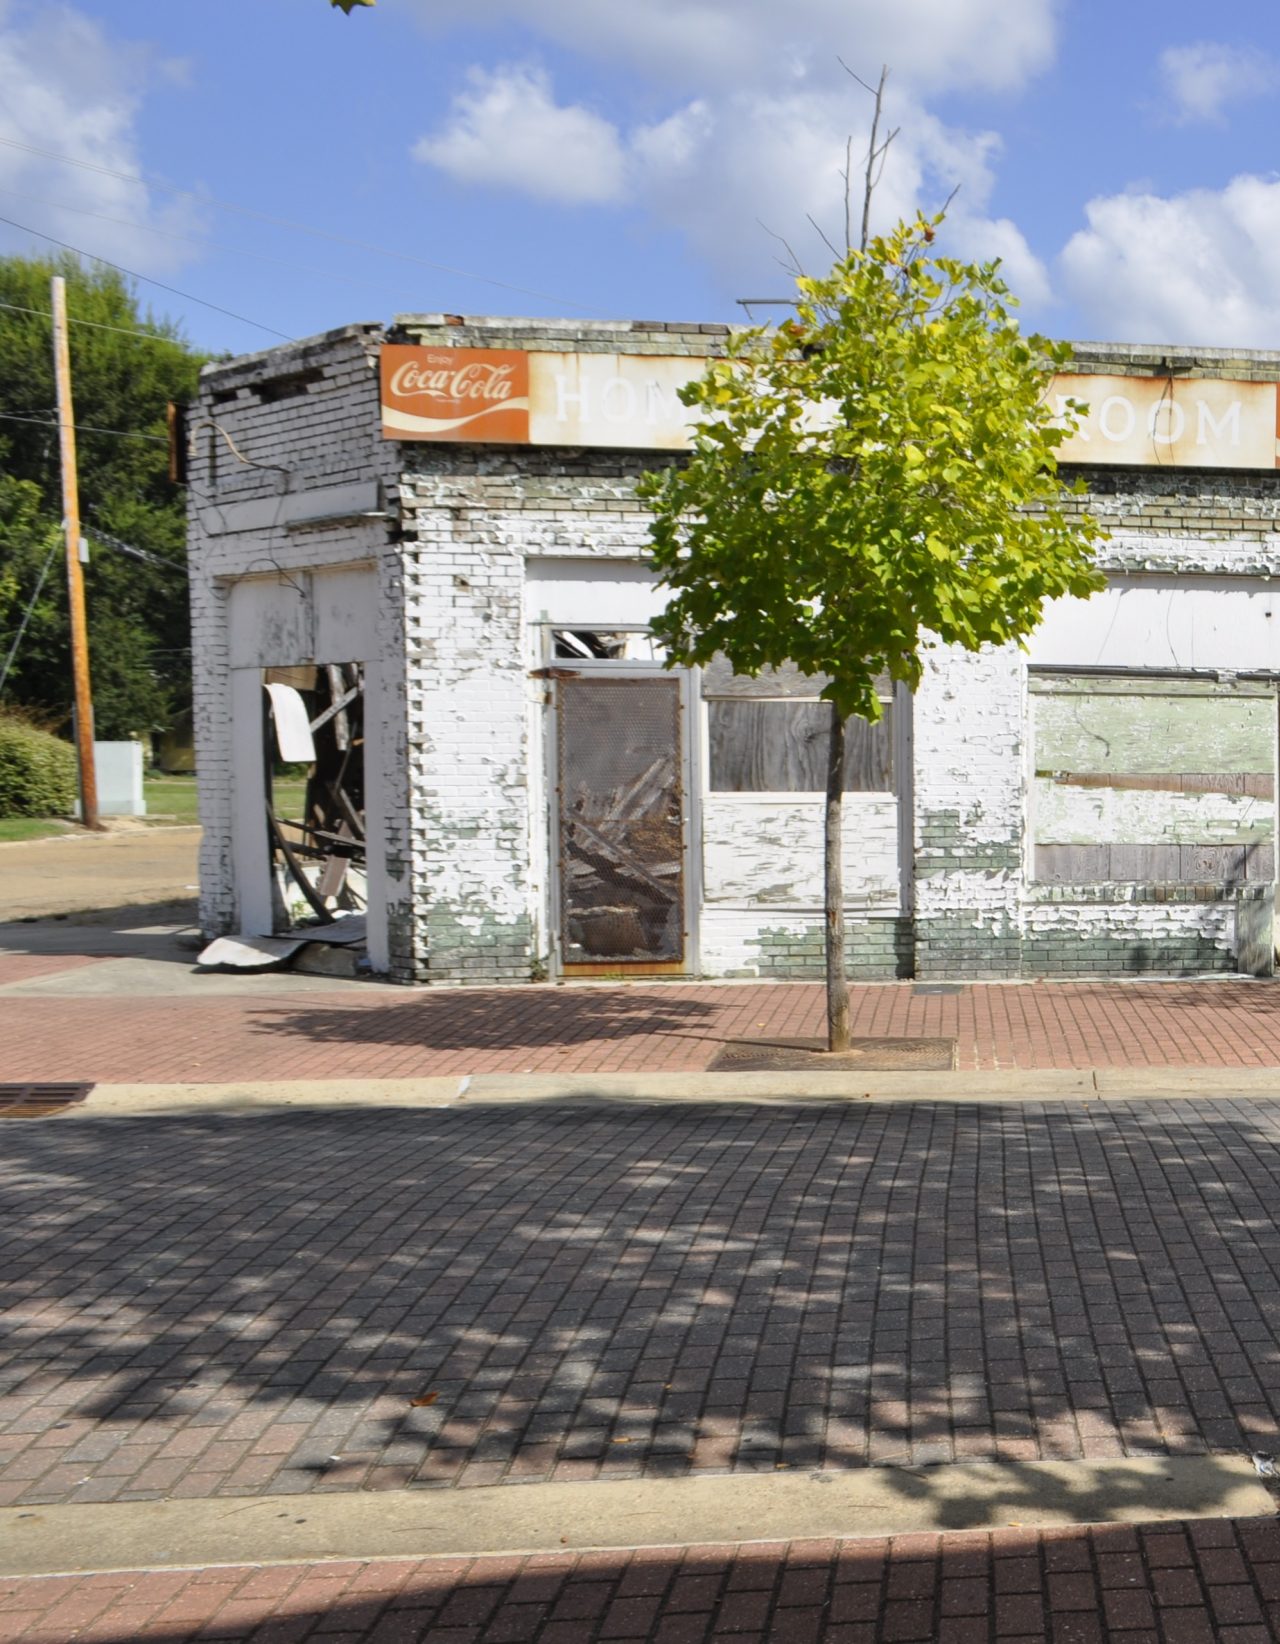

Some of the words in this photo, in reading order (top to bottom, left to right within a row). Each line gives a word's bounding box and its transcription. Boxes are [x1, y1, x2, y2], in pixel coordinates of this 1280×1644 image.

[390, 360, 517, 400] Coca-Cola
[426, 354, 454, 366] Enjoy
[1054, 393, 1243, 446] ROOM
